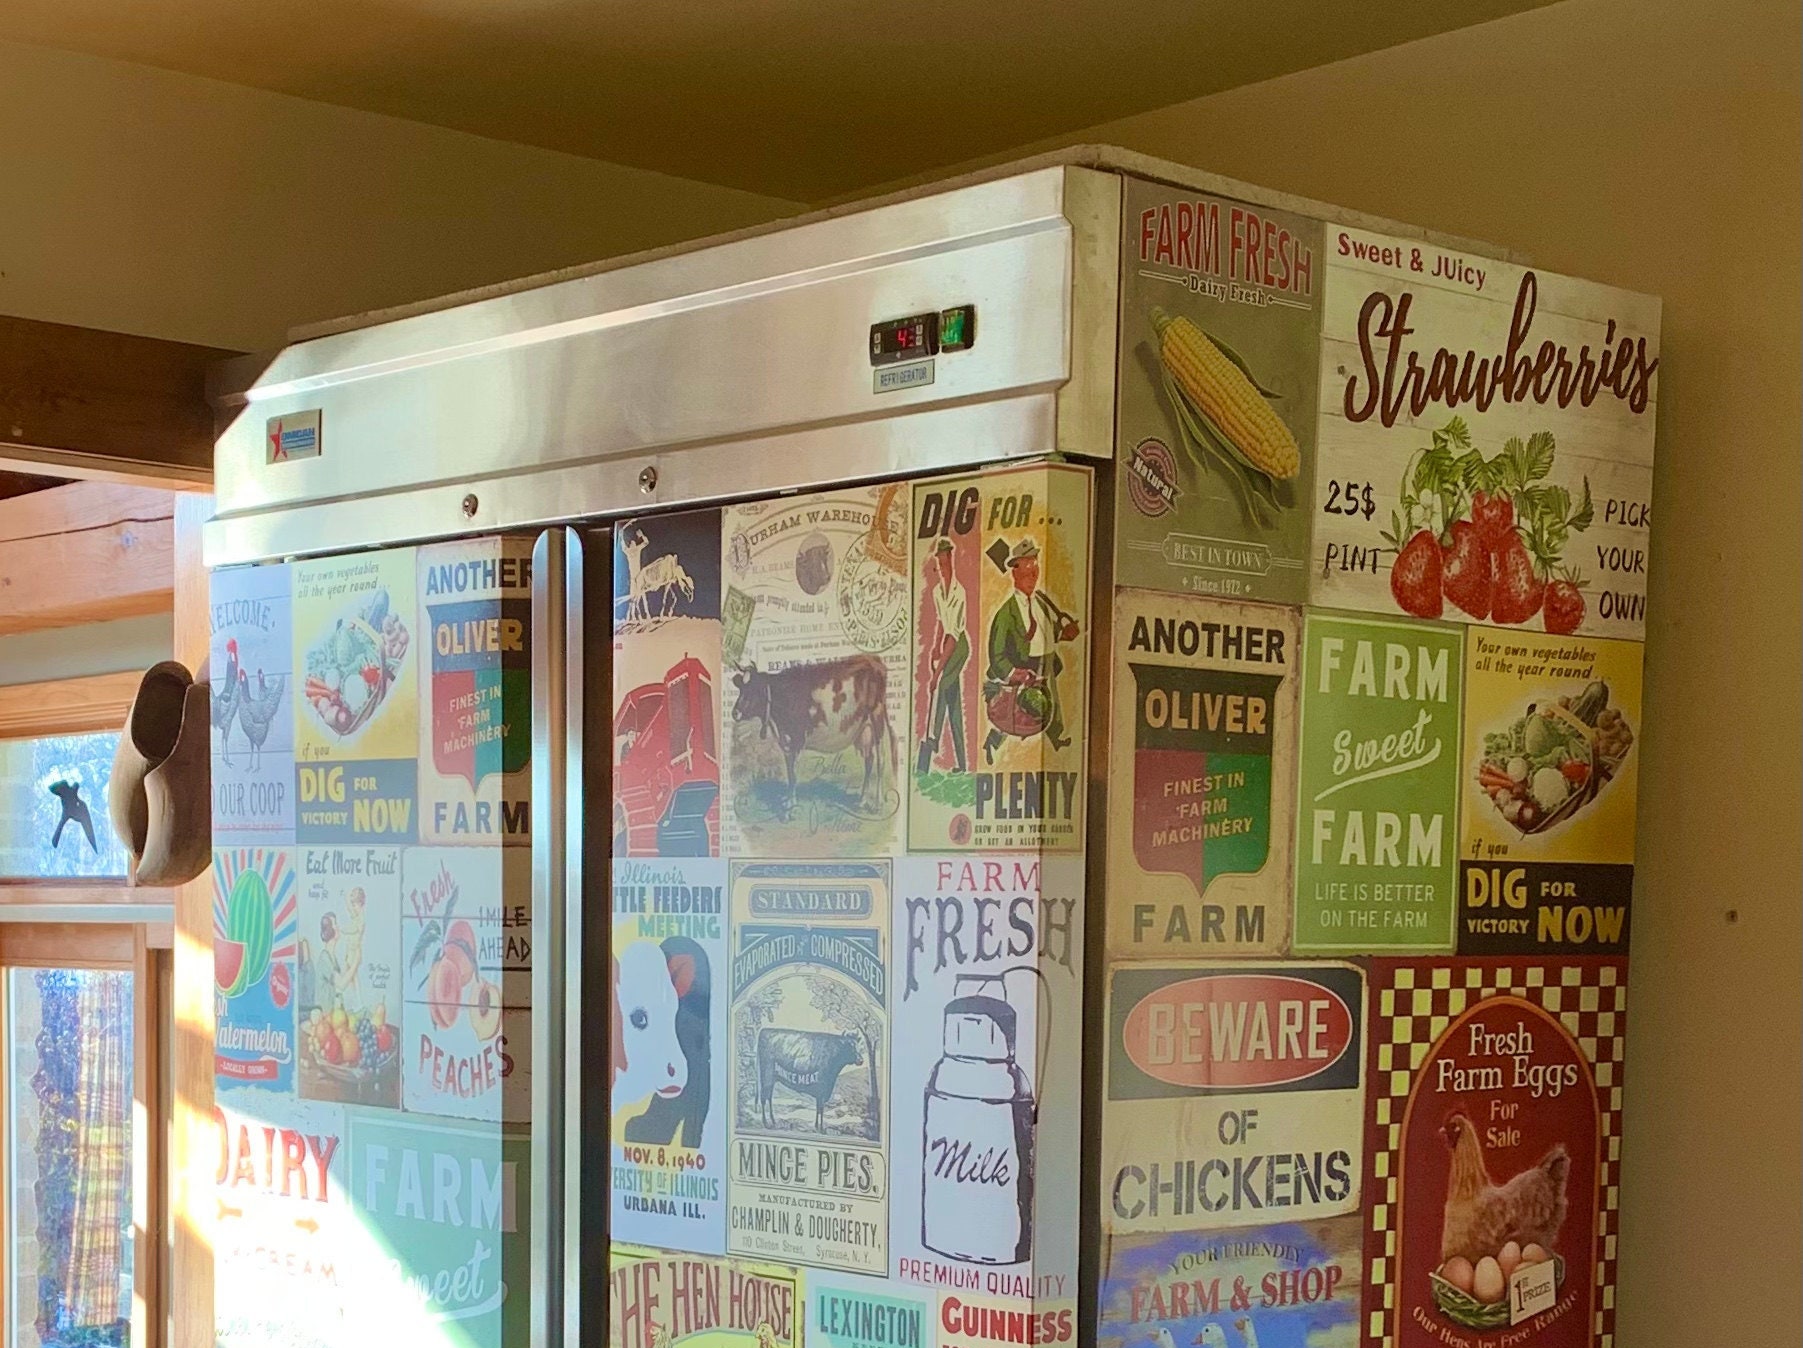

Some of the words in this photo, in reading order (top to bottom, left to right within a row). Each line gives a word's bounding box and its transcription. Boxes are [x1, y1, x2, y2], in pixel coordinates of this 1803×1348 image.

[1140, 201, 1221, 276] FARM
[1229, 206, 1312, 295] FRESH
[1337, 232, 1403, 268] Sweet
[1410, 248, 1424, 272] &
[1230, 285, 1266, 307] Fresh
[1343, 271, 1659, 428] Strawberries
[1133, 456, 1174, 500] Natural
[917, 486, 980, 540] DIG
[1324, 480, 1377, 521] 25$
[1605, 501, 1651, 528] PICK
[1174, 543, 1205, 562] BEST
[1208, 547, 1221, 565] IN
[1224, 549, 1262, 569] TOWN
[1325, 543, 1381, 574] PINT
[1597, 545, 1645, 574] YOUR
[1599, 591, 1646, 622] OWN
[436, 618, 523, 656] OLIVER
[1128, 616, 1286, 664] ANOTHER
[1476, 636, 1501, 654] Your
[1504, 645, 1528, 657] own
[1532, 646, 1597, 663] vegetables
[1318, 637, 1448, 703] FARM
[1475, 657, 1491, 672] all
[1495, 658, 1513, 673] the
[1517, 663, 1546, 681] year
[449, 688, 488, 713] FINEST
[489, 685, 502, 700] IN
[1145, 689, 1267, 734] OLIVER
[458, 708, 491, 730] FARM
[443, 723, 512, 755] MACHINERY
[1332, 709, 1441, 777] Sweet
[219, 783, 245, 816] OUR
[249, 781, 285, 817] COOP
[300, 766, 345, 803] DIG
[354, 776, 377, 792] FOR
[976, 771, 1078, 820] PLENTY
[1163, 774, 1223, 797] FINEST
[1228, 771, 1245, 789] IN
[302, 811, 348, 826] VICTORY
[353, 797, 411, 834] NOW
[434, 801, 529, 834] FARM
[1179, 798, 1228, 819] FARM
[1152, 817, 1253, 848] MACHINERY
[1312, 808, 1444, 869] FARM
[1471, 838, 1483, 859] if
[1487, 843, 1509, 857] you
[306, 850, 329, 875] Eat
[332, 849, 362, 875] More
[366, 849, 397, 876] Fruit
[621, 861, 686, 885] Illinois
[936, 861, 1042, 892] FARM
[654, 886, 723, 914] FEEDERS
[757, 891, 861, 910] STANDARD
[1315, 882, 1348, 901] LIFE
[1353, 883, 1368, 901] IS
[1374, 884, 1435, 902] BETTER
[1467, 868, 1527, 909] DIG
[1541, 881, 1576, 898] FOR
[638, 914, 721, 939] MEETING
[1132, 904, 1266, 944] FARM
[1320, 909, 1343, 928] ON
[1348, 910, 1379, 928] THE
[1383, 910, 1428, 929] FARM
[1467, 918, 1530, 936] VICTORY
[1537, 906, 1626, 945] NOW
[479, 935, 531, 963] AHEAD
[734, 934, 796, 991] EVAPORATED
[810, 934, 884, 996] COMPRESSED
[904, 896, 1077, 1001] FRESH
[1147, 999, 1331, 1066] BEWARE
[1468, 1022, 1534, 1058] Fresh
[420, 1034, 515, 1099] PEACHES
[1436, 1058, 1503, 1094] Farm
[1511, 1055, 1579, 1097] Eggs
[1218, 1108, 1259, 1146] OF
[1490, 1100, 1519, 1122] For
[1485, 1126, 1522, 1150] Sale
[623, 1146, 653, 1165] NOV.
[672, 1152, 706, 1172] 1940
[738, 1142, 807, 1185] MINCE
[817, 1149, 880, 1194] PIES.
[931, 1137, 1012, 1188] Milk
[365, 1143, 518, 1233] FARM
[670, 1173, 719, 1201] ILLINOIS
[1111, 1150, 1352, 1220] CHICKENS
[623, 1195, 678, 1216] URBANA
[683, 1202, 706, 1220] ILL.
[758, 1193, 836, 1212] MANUFACTURED
[839, 1202, 854, 1214] BY
[731, 1205, 790, 1235] CHAMPLIN
[794, 1213, 805, 1237] &
[808, 1214, 881, 1250] DOUGHERTY,
[899, 1257, 980, 1290] PREMIUM
[986, 1268, 1067, 1300] QUALITY
[1169, 1246, 1218, 1276] YOUR
[668, 1261, 720, 1339] HEN
[728, 1269, 792, 1340] HOUSE
[1130, 1278, 1222, 1324] FARM
[1229, 1274, 1253, 1312] &
[1260, 1264, 1343, 1309] SHOP
[1523, 1281, 1553, 1303] PRIZE
[941, 1295, 1073, 1345] GUINNESS
[1413, 1306, 1438, 1334] Our
[1501, 1326, 1531, 1348] Free
